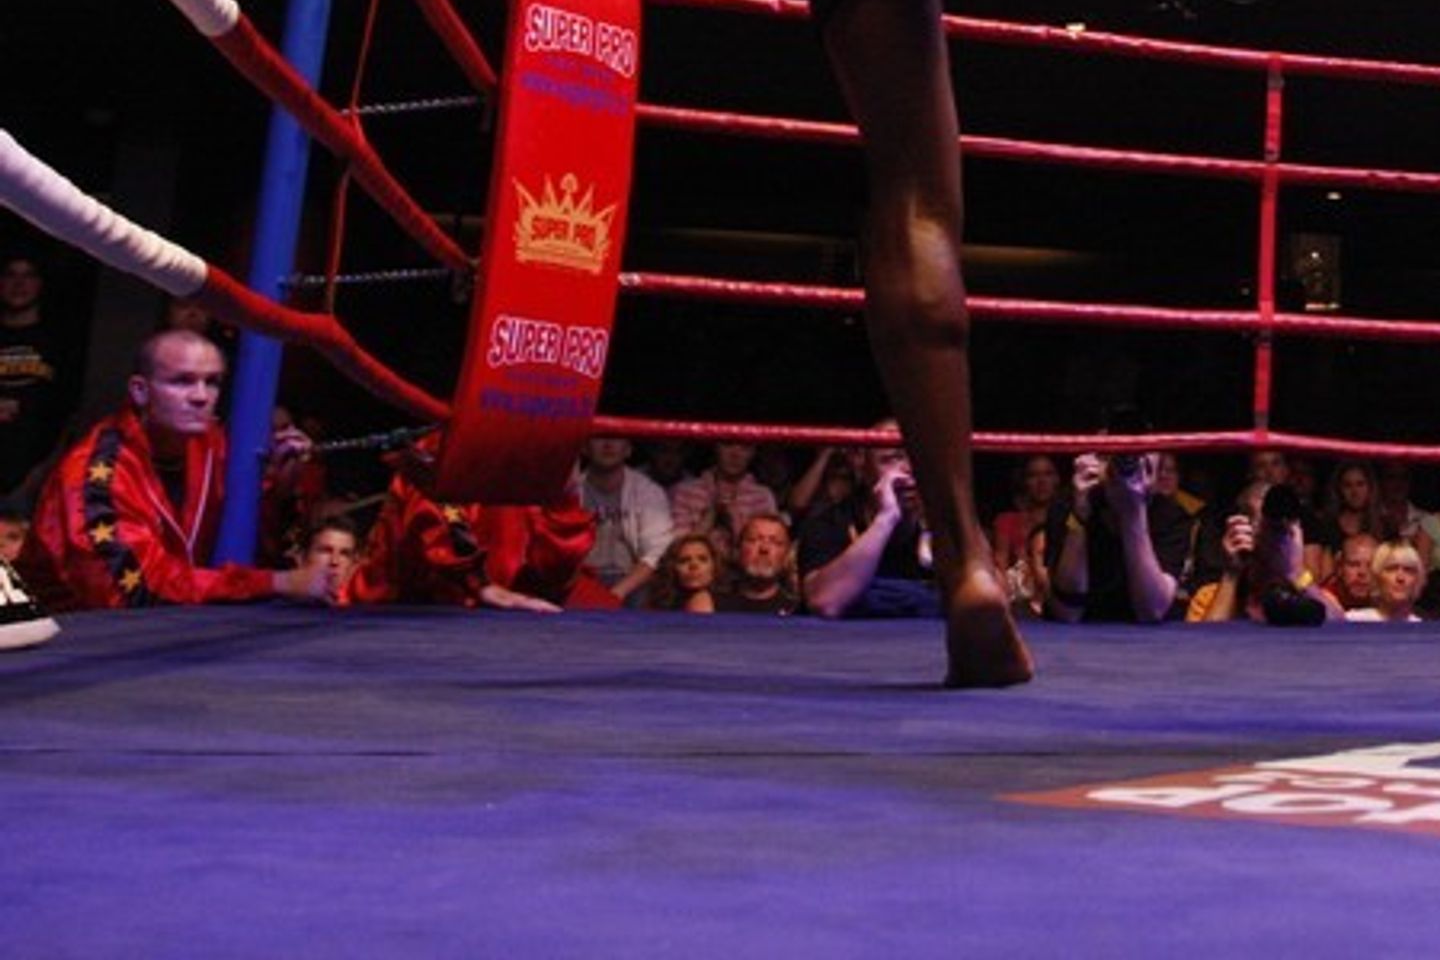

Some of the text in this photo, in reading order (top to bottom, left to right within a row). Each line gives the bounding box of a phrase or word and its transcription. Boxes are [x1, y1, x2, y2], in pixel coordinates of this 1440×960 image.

[525, 3, 593, 56] SUPER
[595, 22, 638, 78] PRO
[488, 314, 609, 379] SUPER PRO
